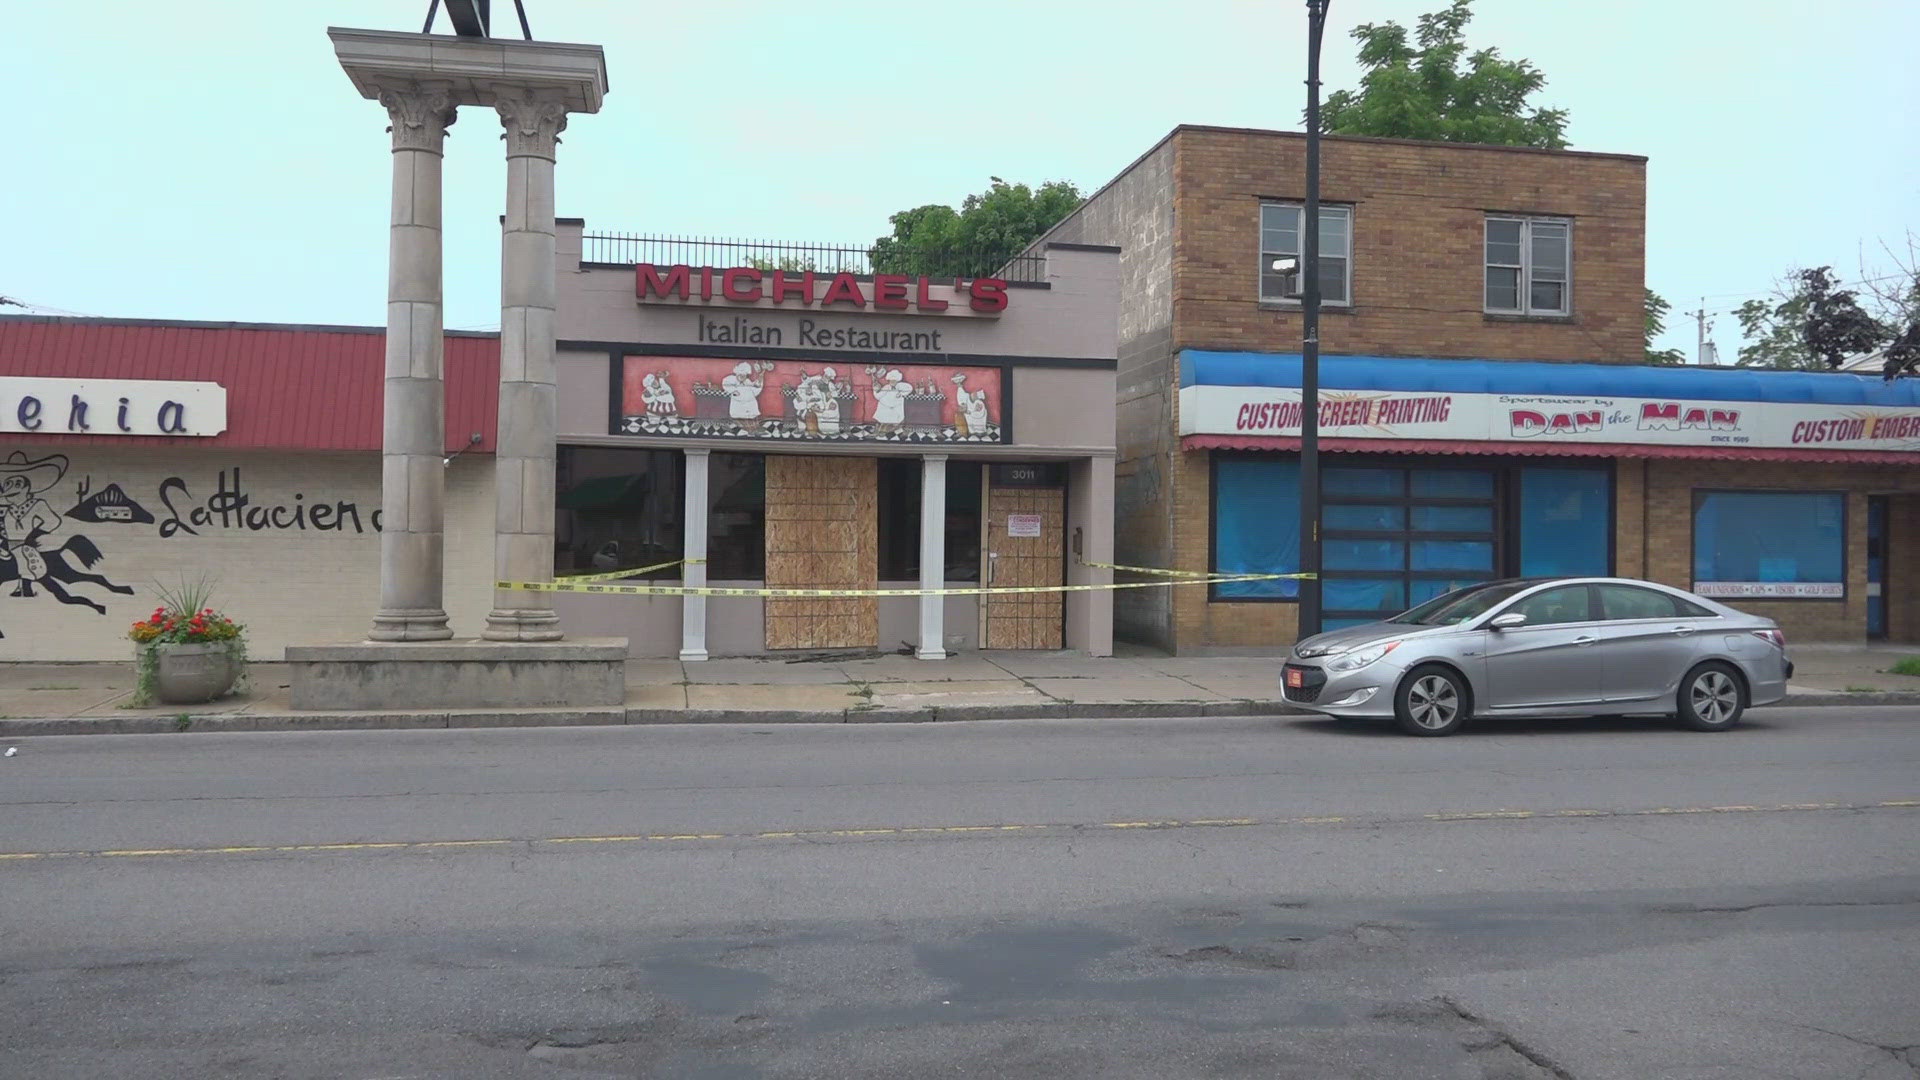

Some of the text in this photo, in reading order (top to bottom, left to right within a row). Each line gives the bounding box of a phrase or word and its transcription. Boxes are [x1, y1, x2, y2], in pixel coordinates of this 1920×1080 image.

[635, 263, 1009, 313] MICHAEL'S
[699, 313, 942, 351] Italian Restaurant
[1376, 396, 1452, 425] PRINTING
[1499, 395, 1614, 407] Sportswear by
[1508, 402, 1741, 438] DAN the MAN
[1791, 418, 1867, 444] CUSTOM
[1012, 470, 1036, 480] 3011
